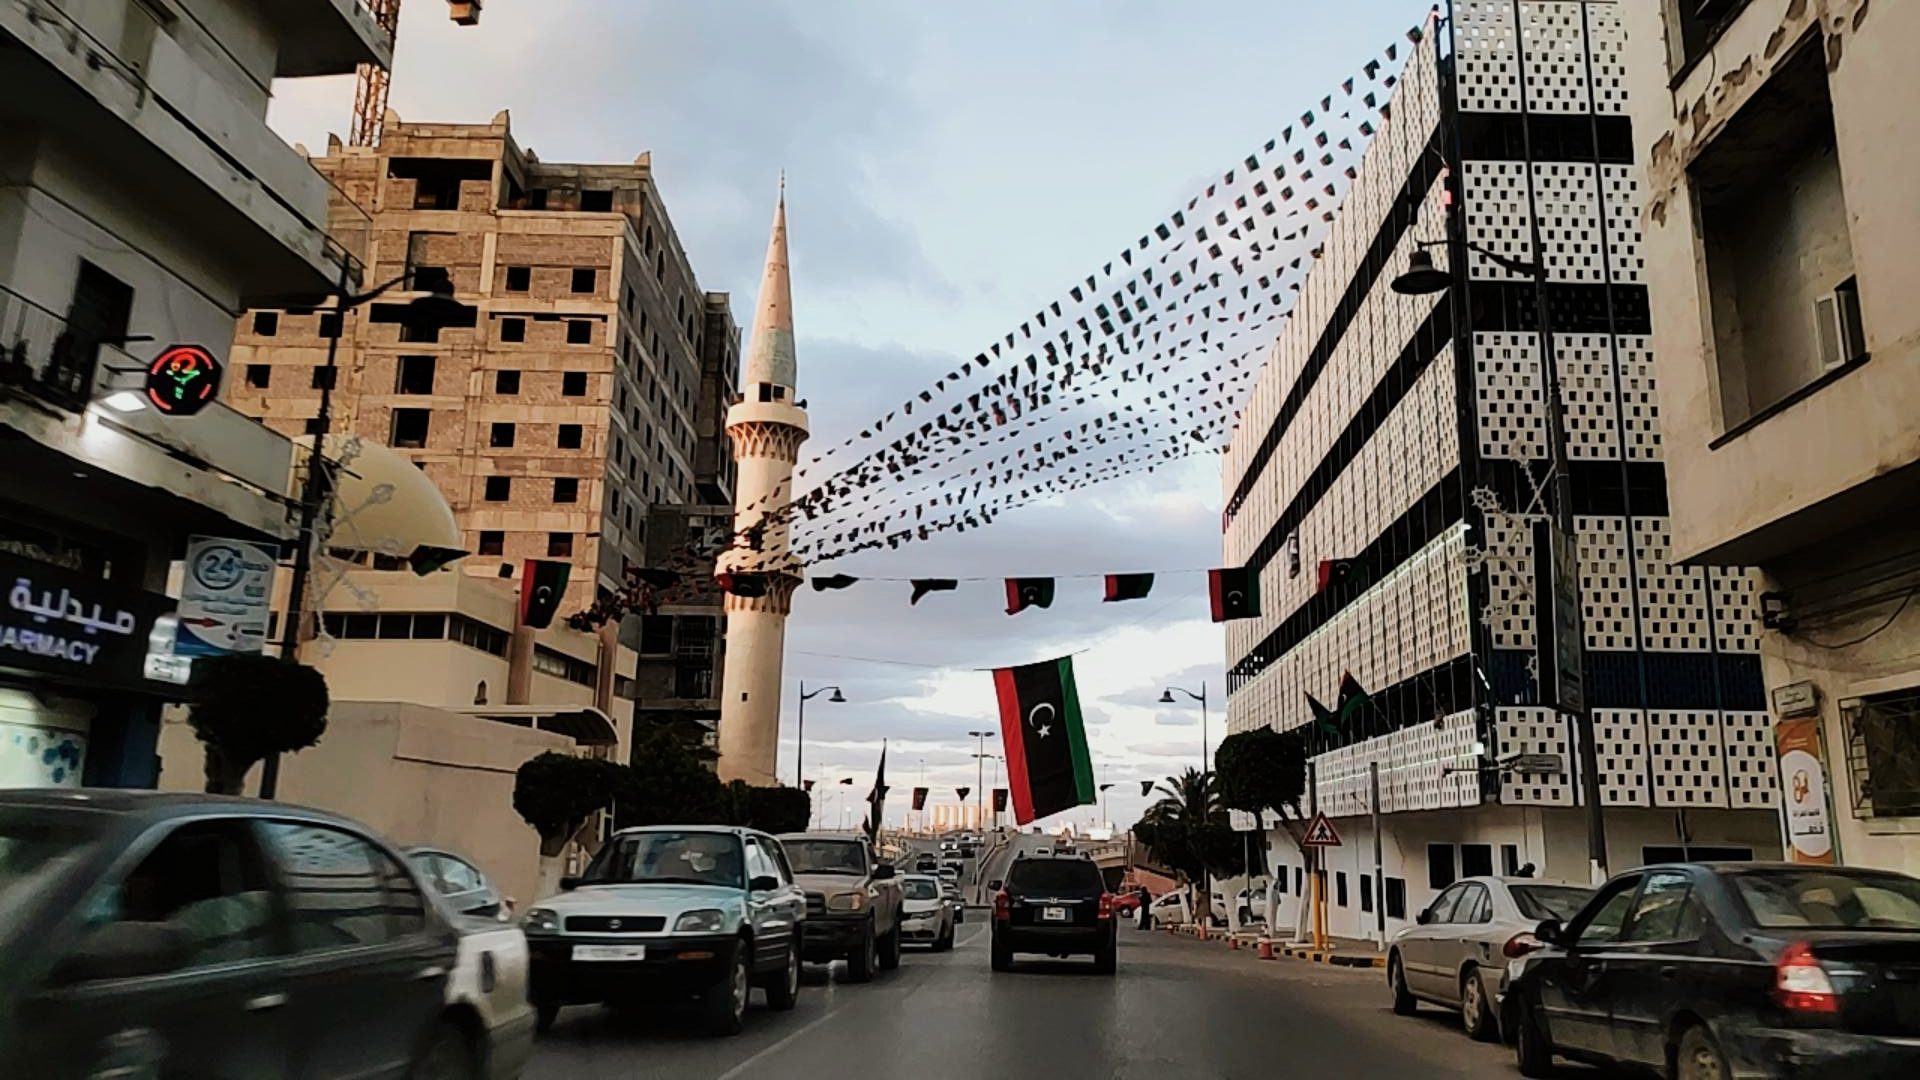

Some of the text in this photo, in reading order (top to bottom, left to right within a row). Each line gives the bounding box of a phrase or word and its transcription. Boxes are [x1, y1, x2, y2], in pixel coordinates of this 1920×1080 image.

[205, 554, 234, 574] 24
[9, 577, 135, 635] صيدلية
[0, 624, 100, 665] ARMACY
